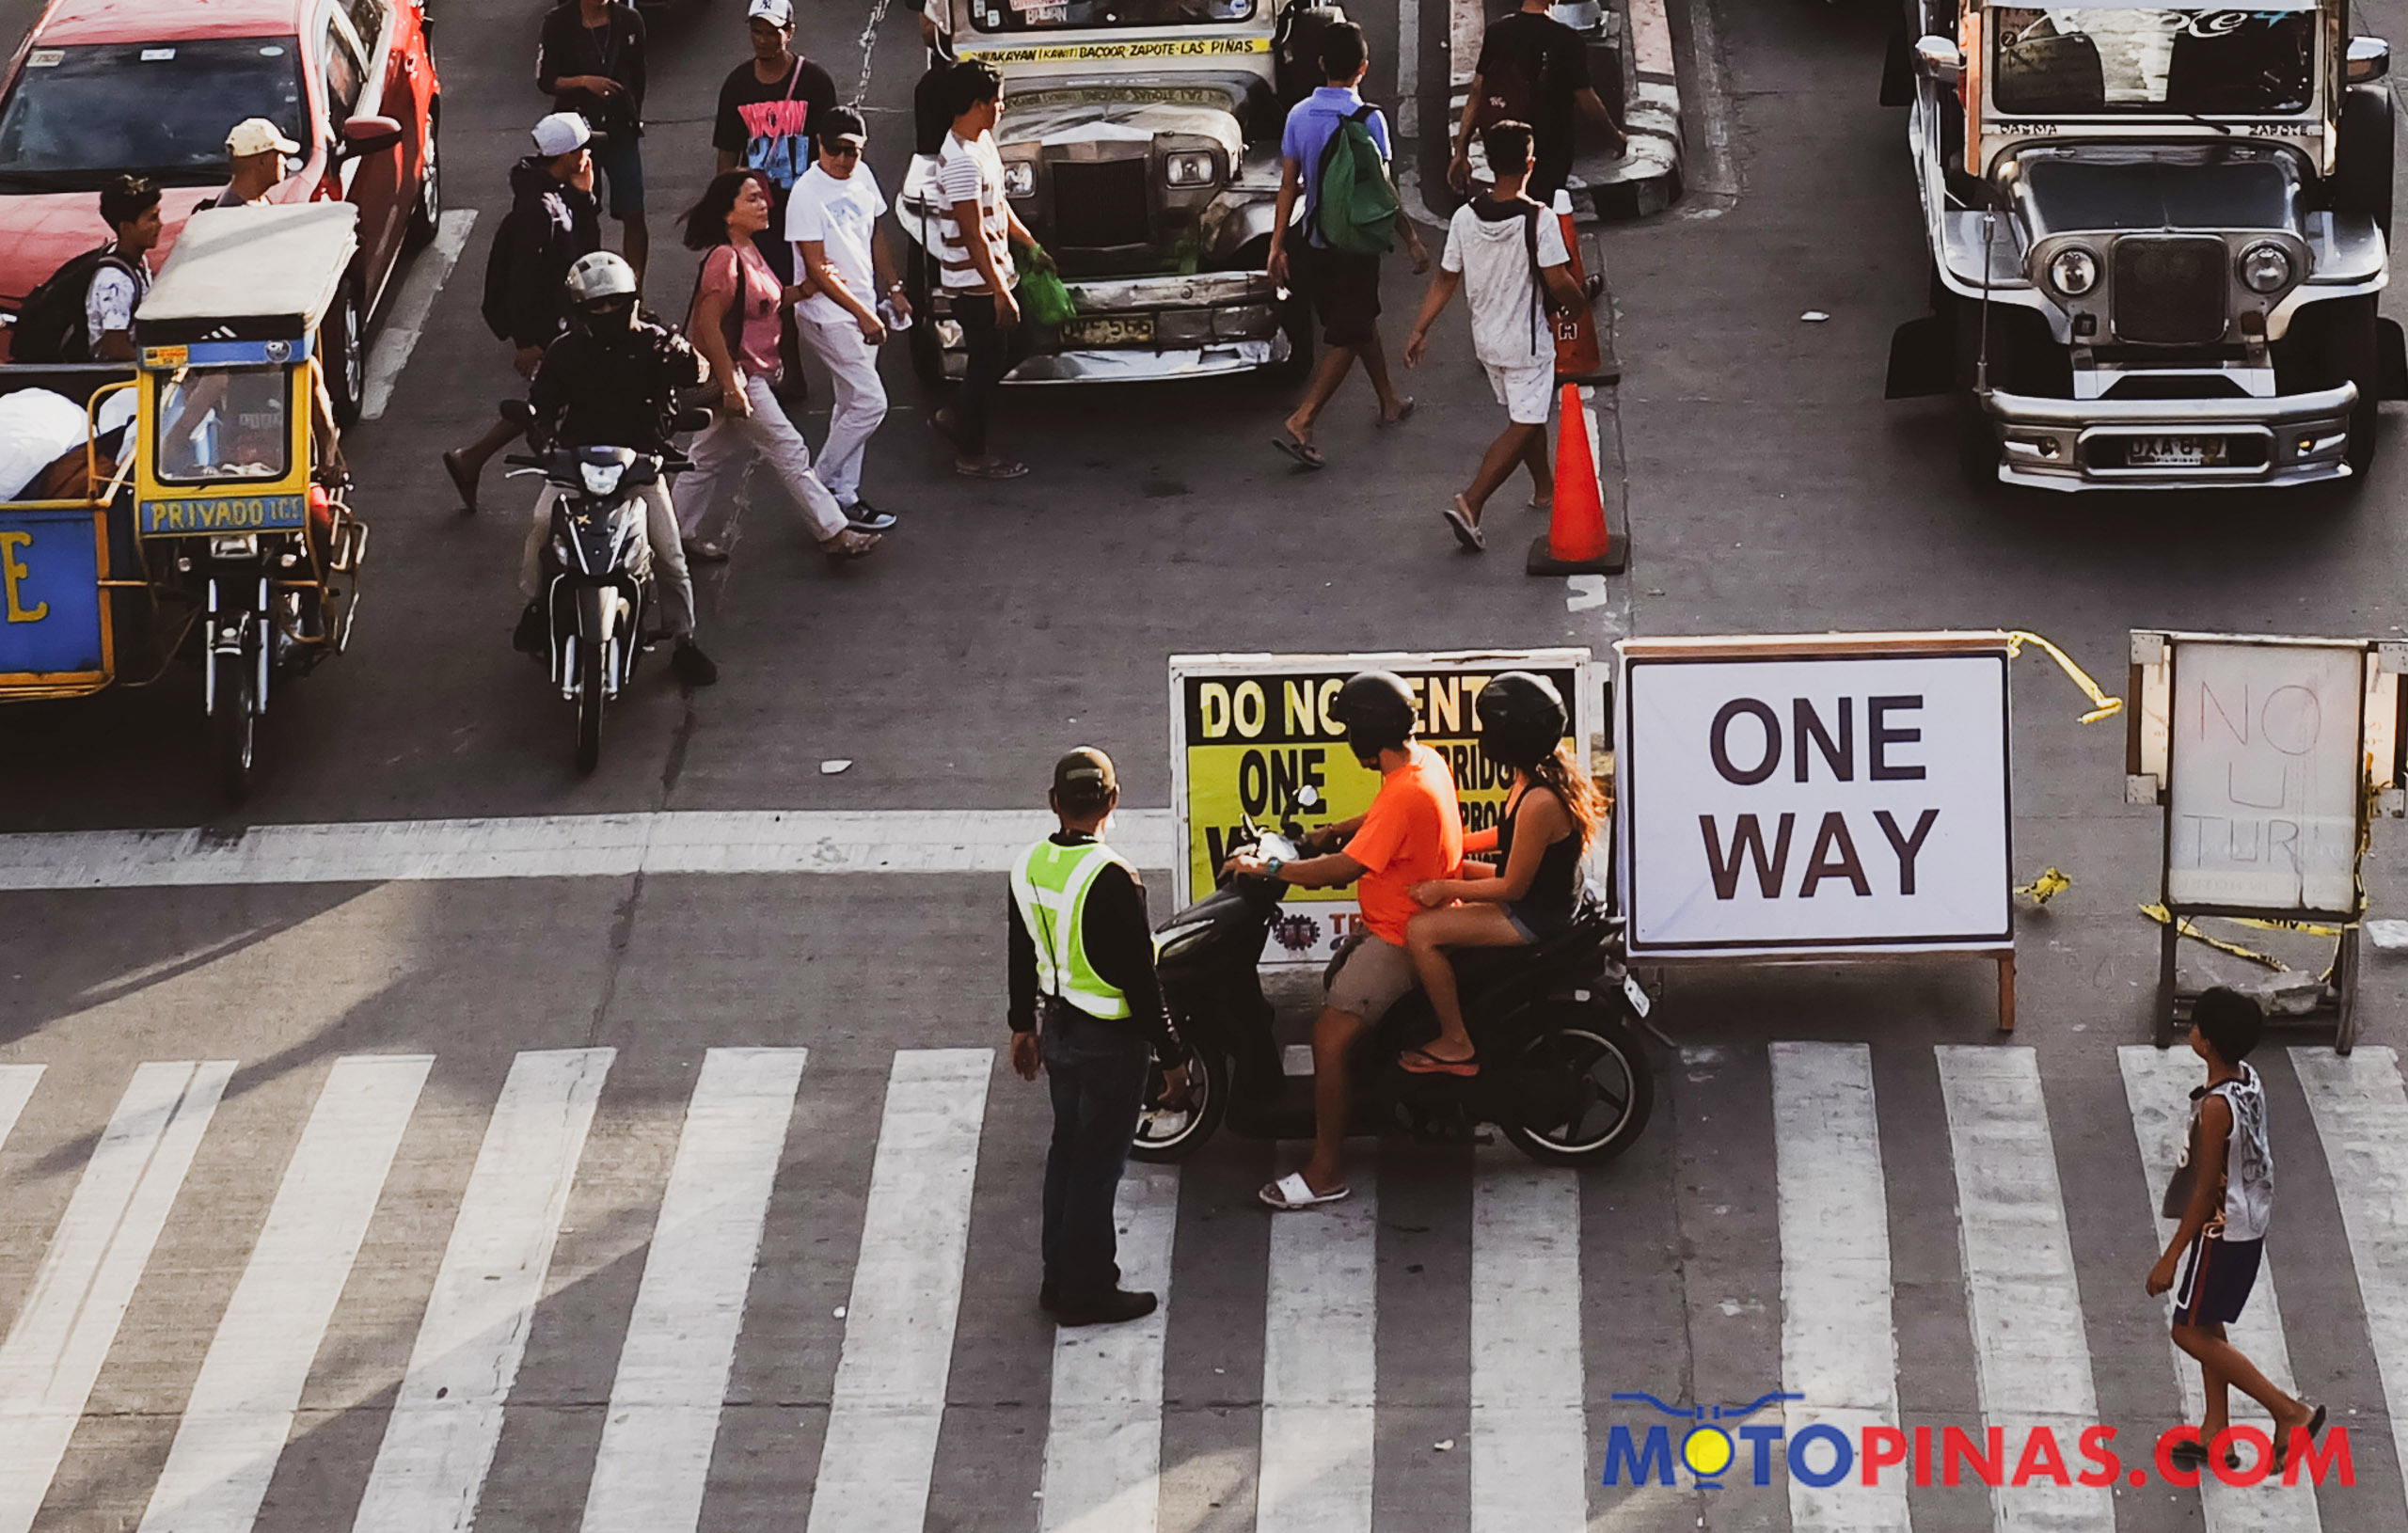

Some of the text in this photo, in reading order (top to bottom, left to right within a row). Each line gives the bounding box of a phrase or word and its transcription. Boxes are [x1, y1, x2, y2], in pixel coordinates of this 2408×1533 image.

[1130, 43, 1175, 56] ZAPOTE
[151, 500, 264, 531] PRIVADO
[1199, 674, 1494, 739] DO NO ENT
[1710, 694, 1927, 786] ONE
[2199, 680, 2322, 756] NO
[1239, 747, 1328, 818] ONE
[2228, 761, 2288, 810] U
[1698, 808, 1941, 901] WAY
